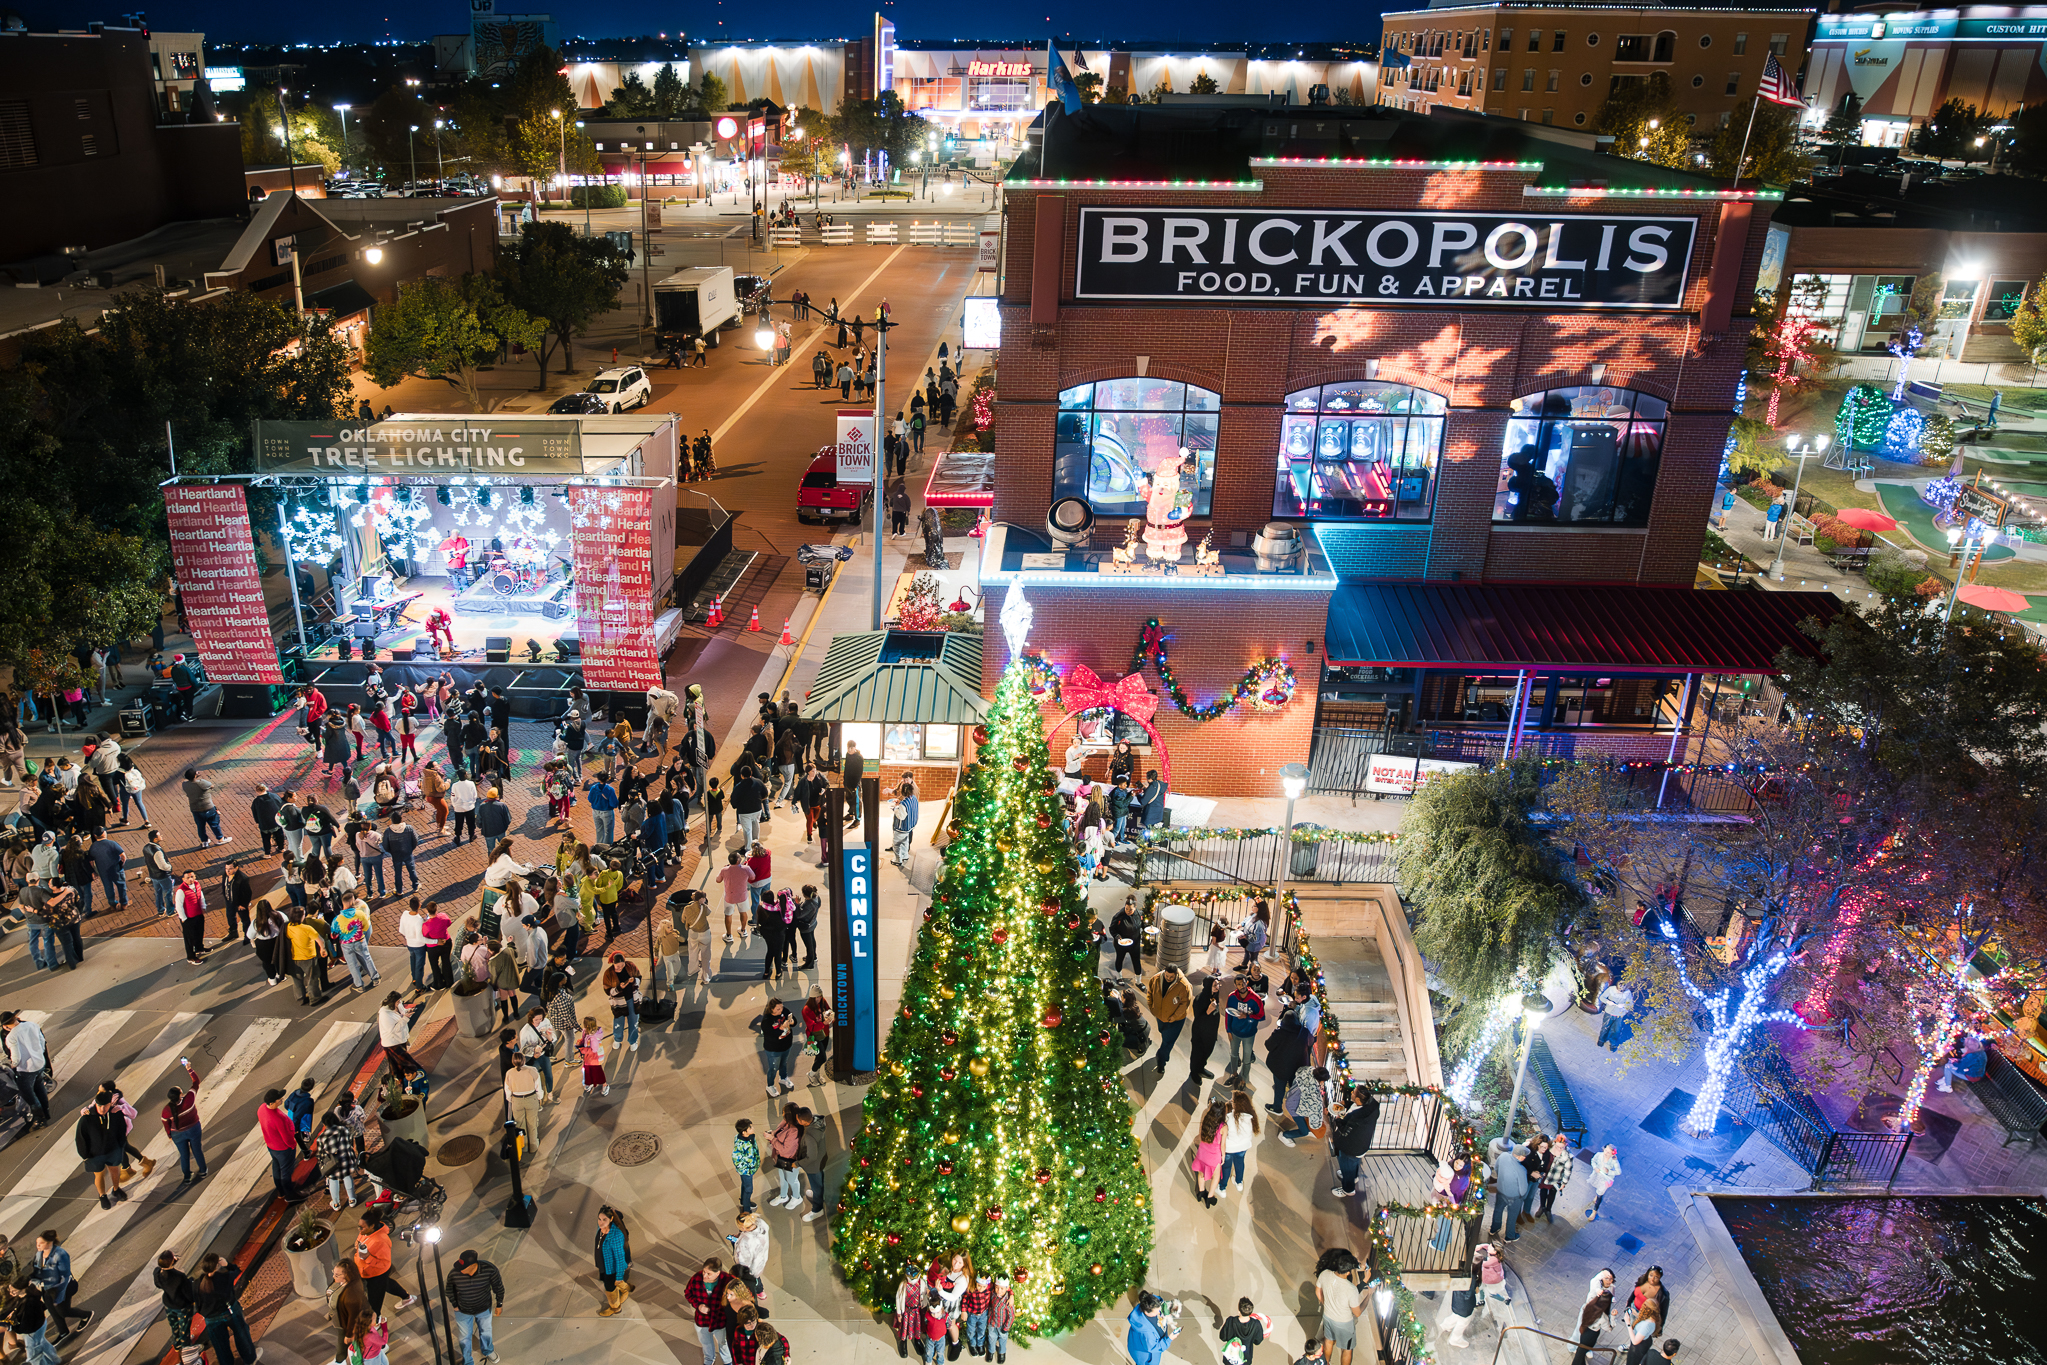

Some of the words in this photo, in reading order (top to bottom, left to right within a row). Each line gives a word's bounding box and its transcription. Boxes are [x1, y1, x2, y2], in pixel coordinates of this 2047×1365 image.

[1891, 26, 1914, 35] MOVING
[1913, 25, 1940, 34] SUPPLIES
[1985, 25, 2026, 34] CUSTOM
[967, 61, 1032, 76] Harkins
[1098, 217, 1676, 274] BRICKOPOLIS
[1177, 270, 1282, 297] FOOD,
[1295, 273, 1364, 295] FUN
[1377, 274, 1400, 295] &
[1414, 275, 1582, 299] APPAREL
[339, 428, 444, 444] OKLAHOMA
[450, 428, 493, 443] CITY
[838, 442, 871, 455] BRICK
[307, 447, 380, 467] TREE
[390, 446, 526, 467] LIGHTING
[838, 455, 871, 467] TOWN
[179, 487, 237, 501] Heartland
[170, 528, 226, 540] Heartland
[628, 531, 652, 545] Hea
[186, 553, 244, 566] Heartland
[191, 566, 249, 579] Heartland
[185, 604, 241, 616] Heartland
[203, 627, 260, 639] Heartland
[209, 638, 265, 650] Heartland
[593, 645, 648, 659] Heartland
[206, 672, 260, 682] Heartland
[584, 678, 639, 690] Heartland
[1372, 766, 1396, 777] NOT
[1396, 769, 1412, 779] AN
[1374, 777, 1395, 785] ENTER
[850, 854, 868, 958] CANAL
[836, 962, 848, 1028] BRICKTOWN
